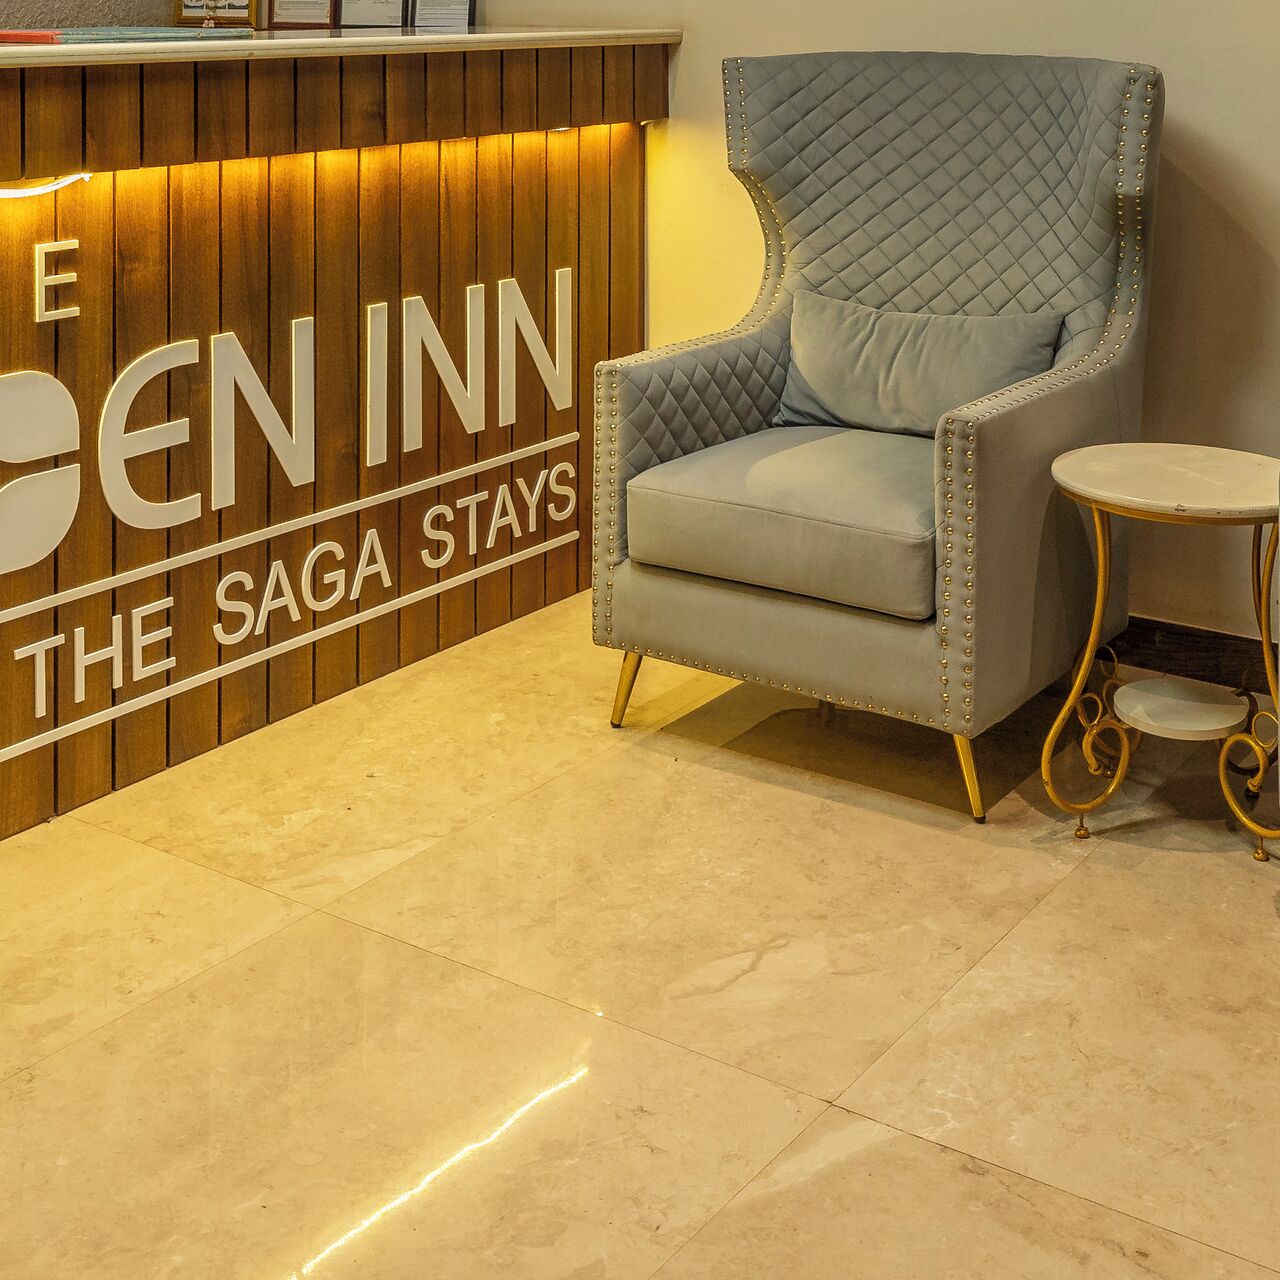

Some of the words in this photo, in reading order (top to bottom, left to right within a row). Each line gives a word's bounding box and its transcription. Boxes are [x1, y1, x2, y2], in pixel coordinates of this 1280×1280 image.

[366, 267, 574, 468] INN
[14, 596, 177, 719] THE
[212, 528, 393, 646] SAGA
[421, 461, 578, 570] STAYS
